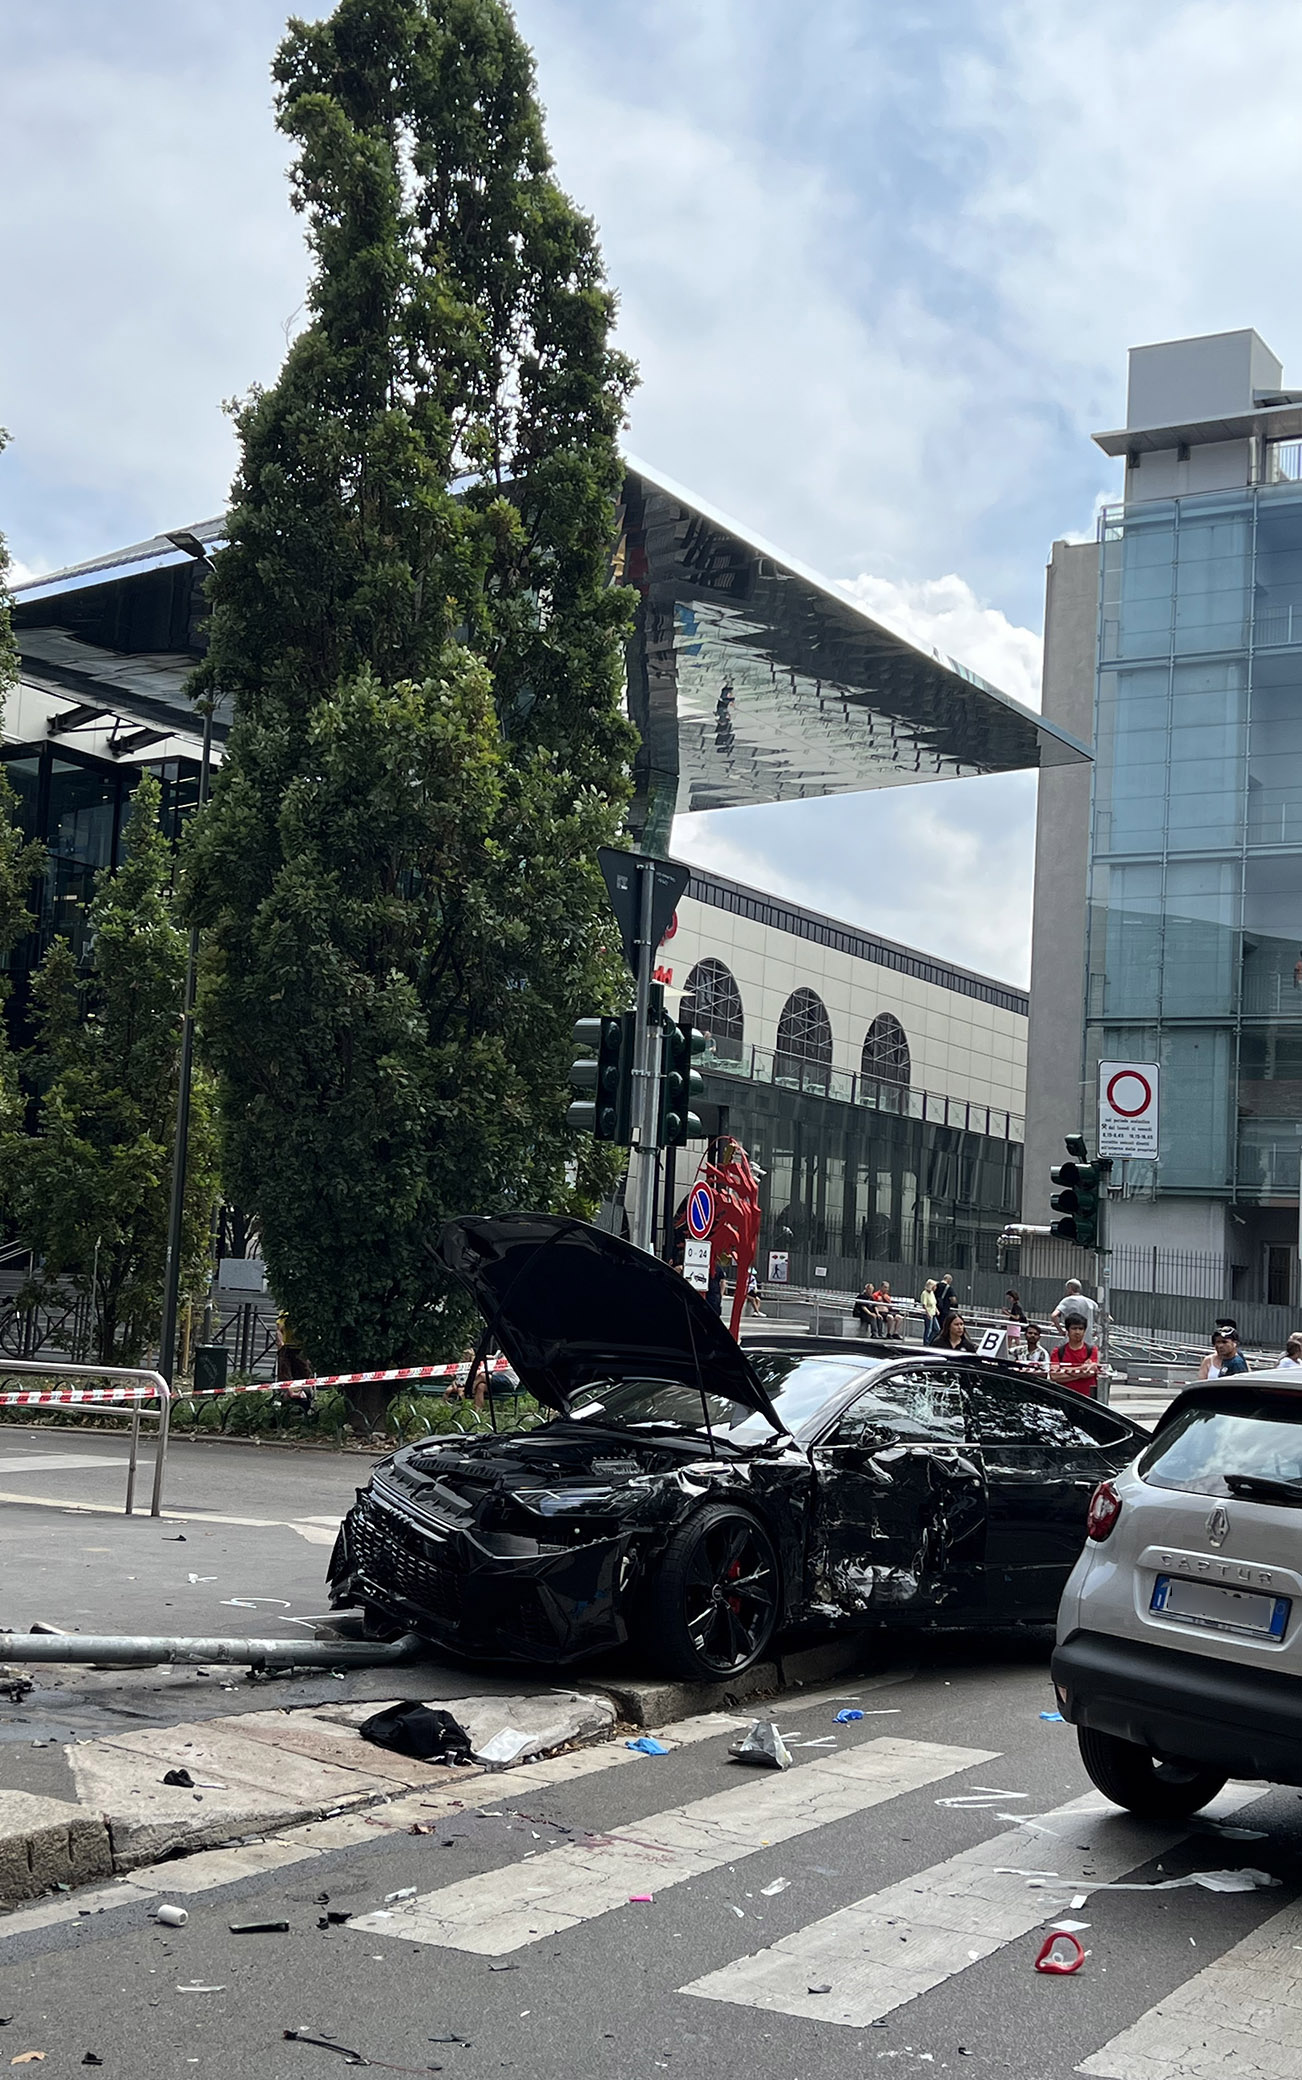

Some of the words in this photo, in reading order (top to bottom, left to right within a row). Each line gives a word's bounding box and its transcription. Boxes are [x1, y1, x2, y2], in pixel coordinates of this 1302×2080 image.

[698, 1249, 707, 1258] 24
[982, 1332, 1000, 1350] B
[1160, 1554, 1273, 1584] CAPTUR
